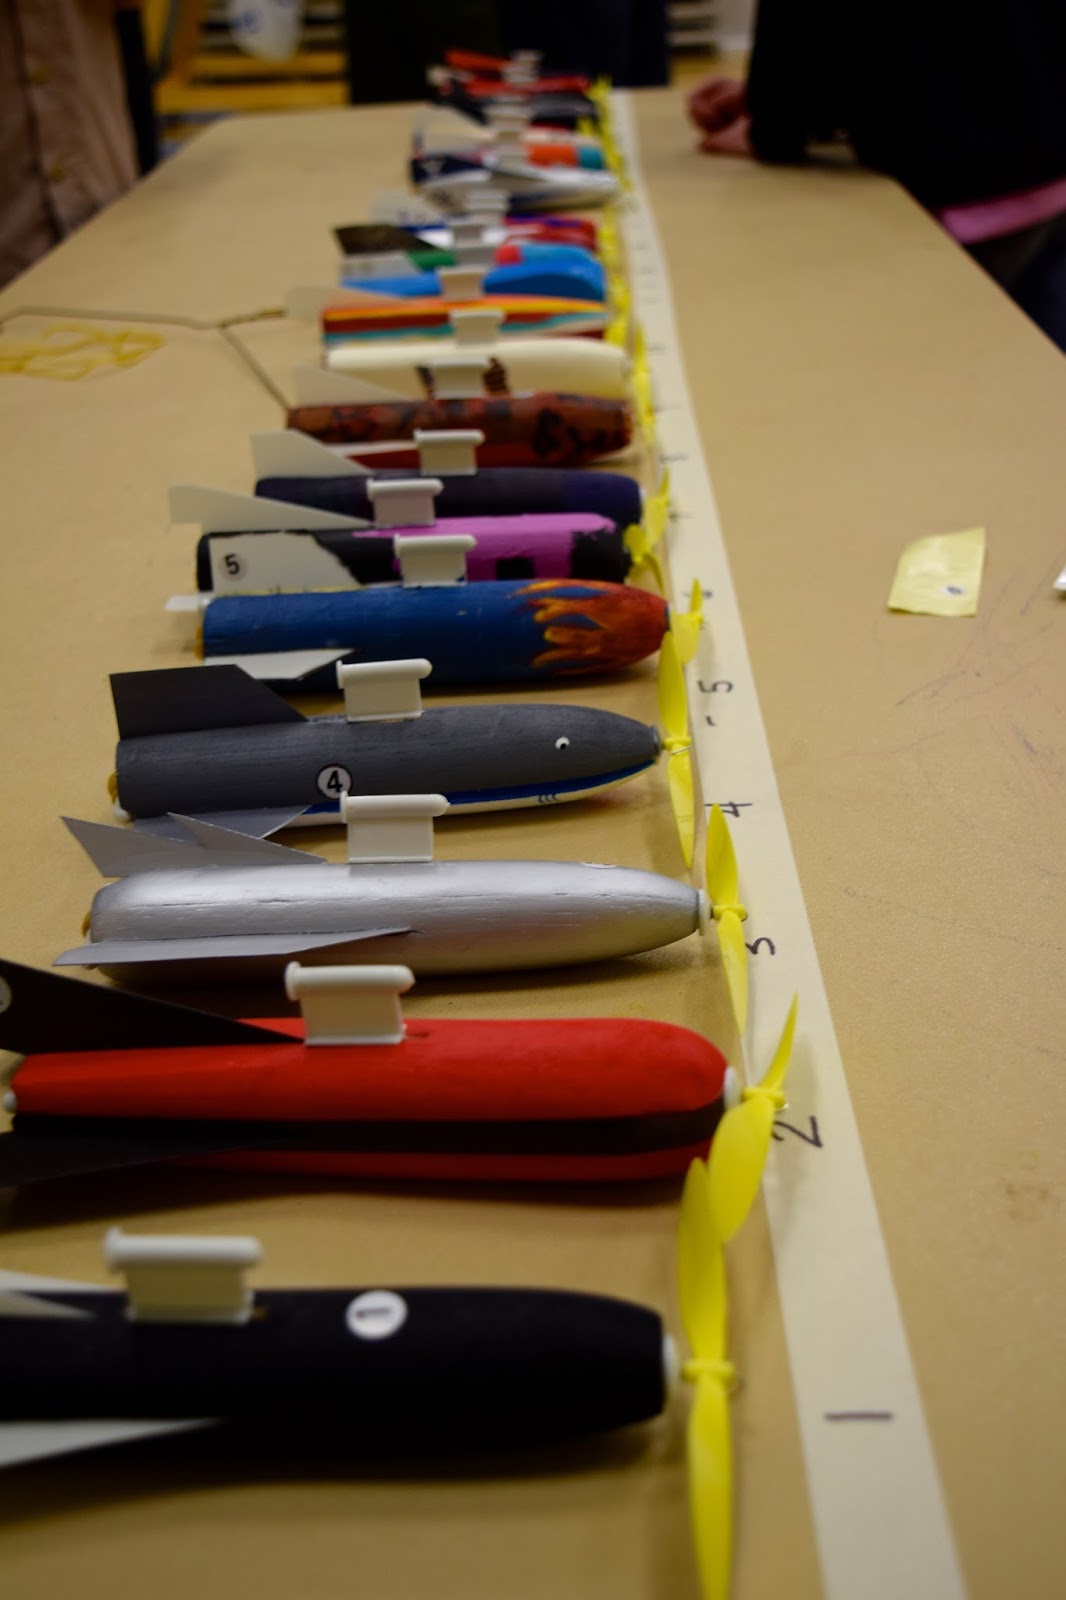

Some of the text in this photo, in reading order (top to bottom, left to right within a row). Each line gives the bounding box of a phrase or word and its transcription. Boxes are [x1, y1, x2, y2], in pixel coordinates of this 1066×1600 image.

[224, 553, 241, 575] 5
[698, 680, 733, 694] 5
[327, 770, 343, 792] 4
[705, 802, 753, 817] 4
[772, 1115, 823, 1149] 2
[824, 1411, 893, 1422] 1
